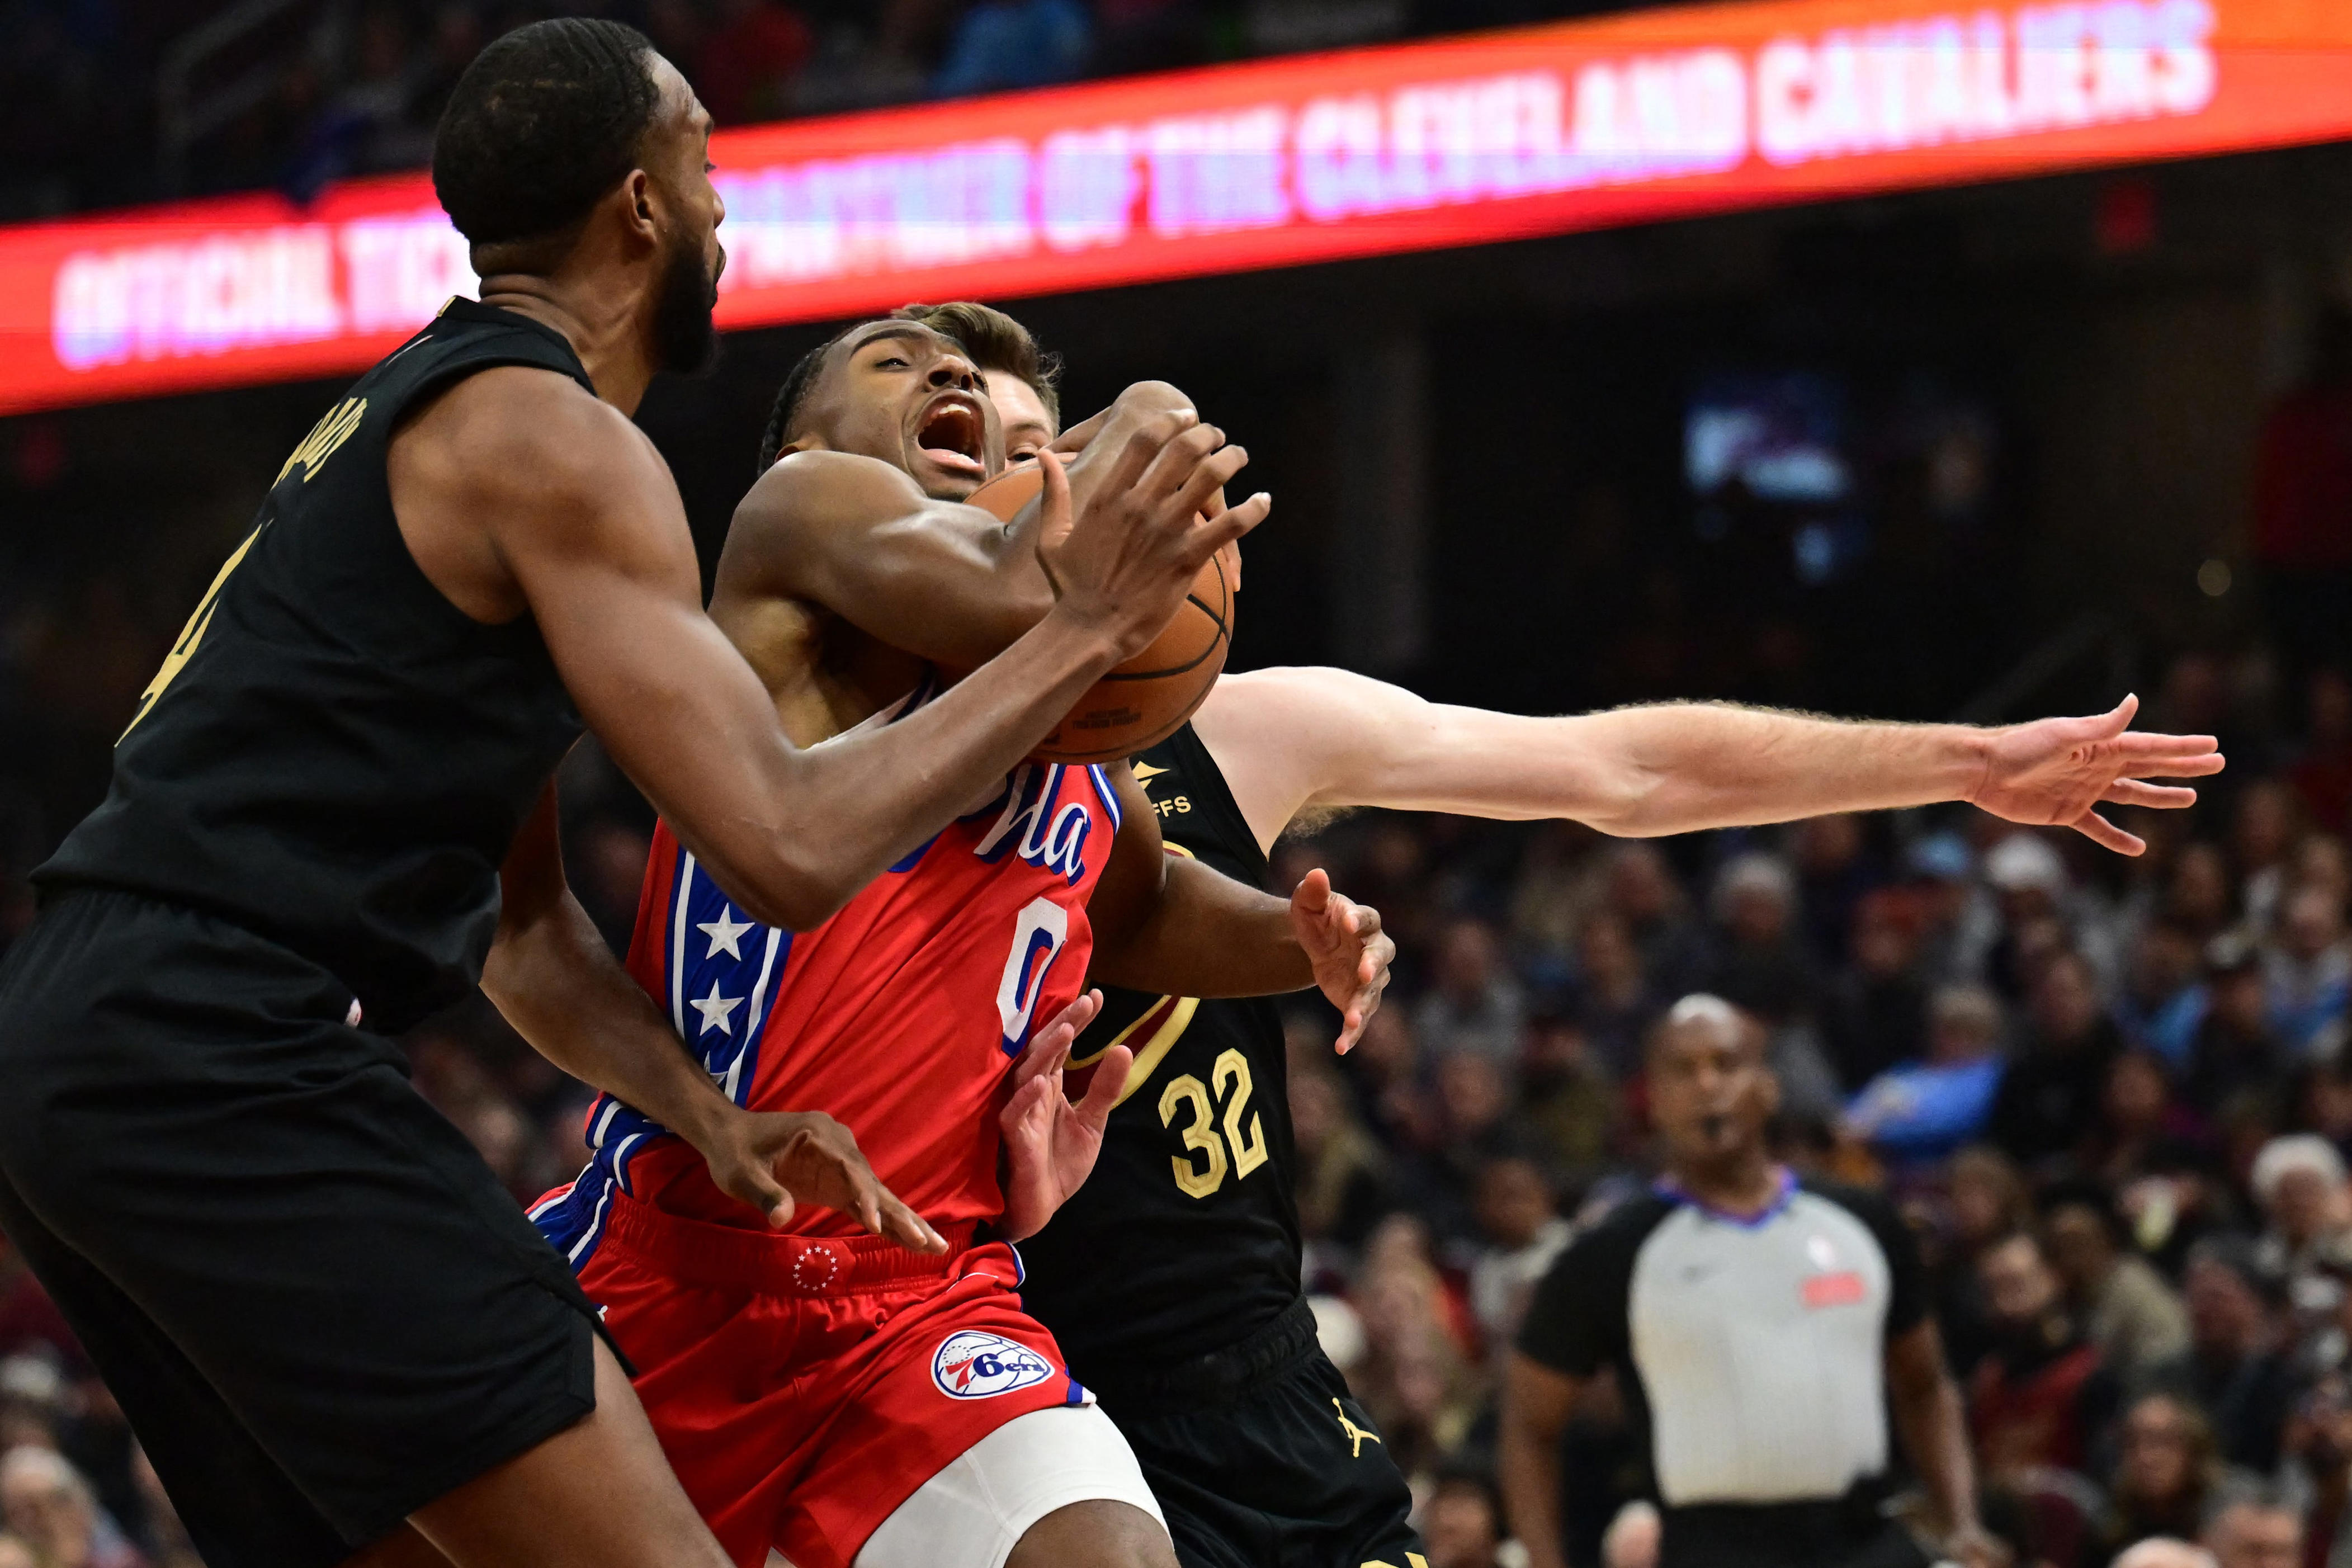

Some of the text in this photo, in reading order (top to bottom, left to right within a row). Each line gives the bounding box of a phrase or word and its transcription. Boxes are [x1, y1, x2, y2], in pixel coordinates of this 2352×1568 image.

[53, 225, 339, 370] OFFICIAL
[1038, 125, 1135, 252] OF
[1139, 106, 1293, 239] THE
[1295, 48, 1748, 223] CLEVELAND
[1754, 0, 2216, 166] CAVALIERS
[996, 896, 1068, 1057] 0
[1158, 1047, 1268, 1198] 32
[945, 1353, 1046, 1391] 76ers
